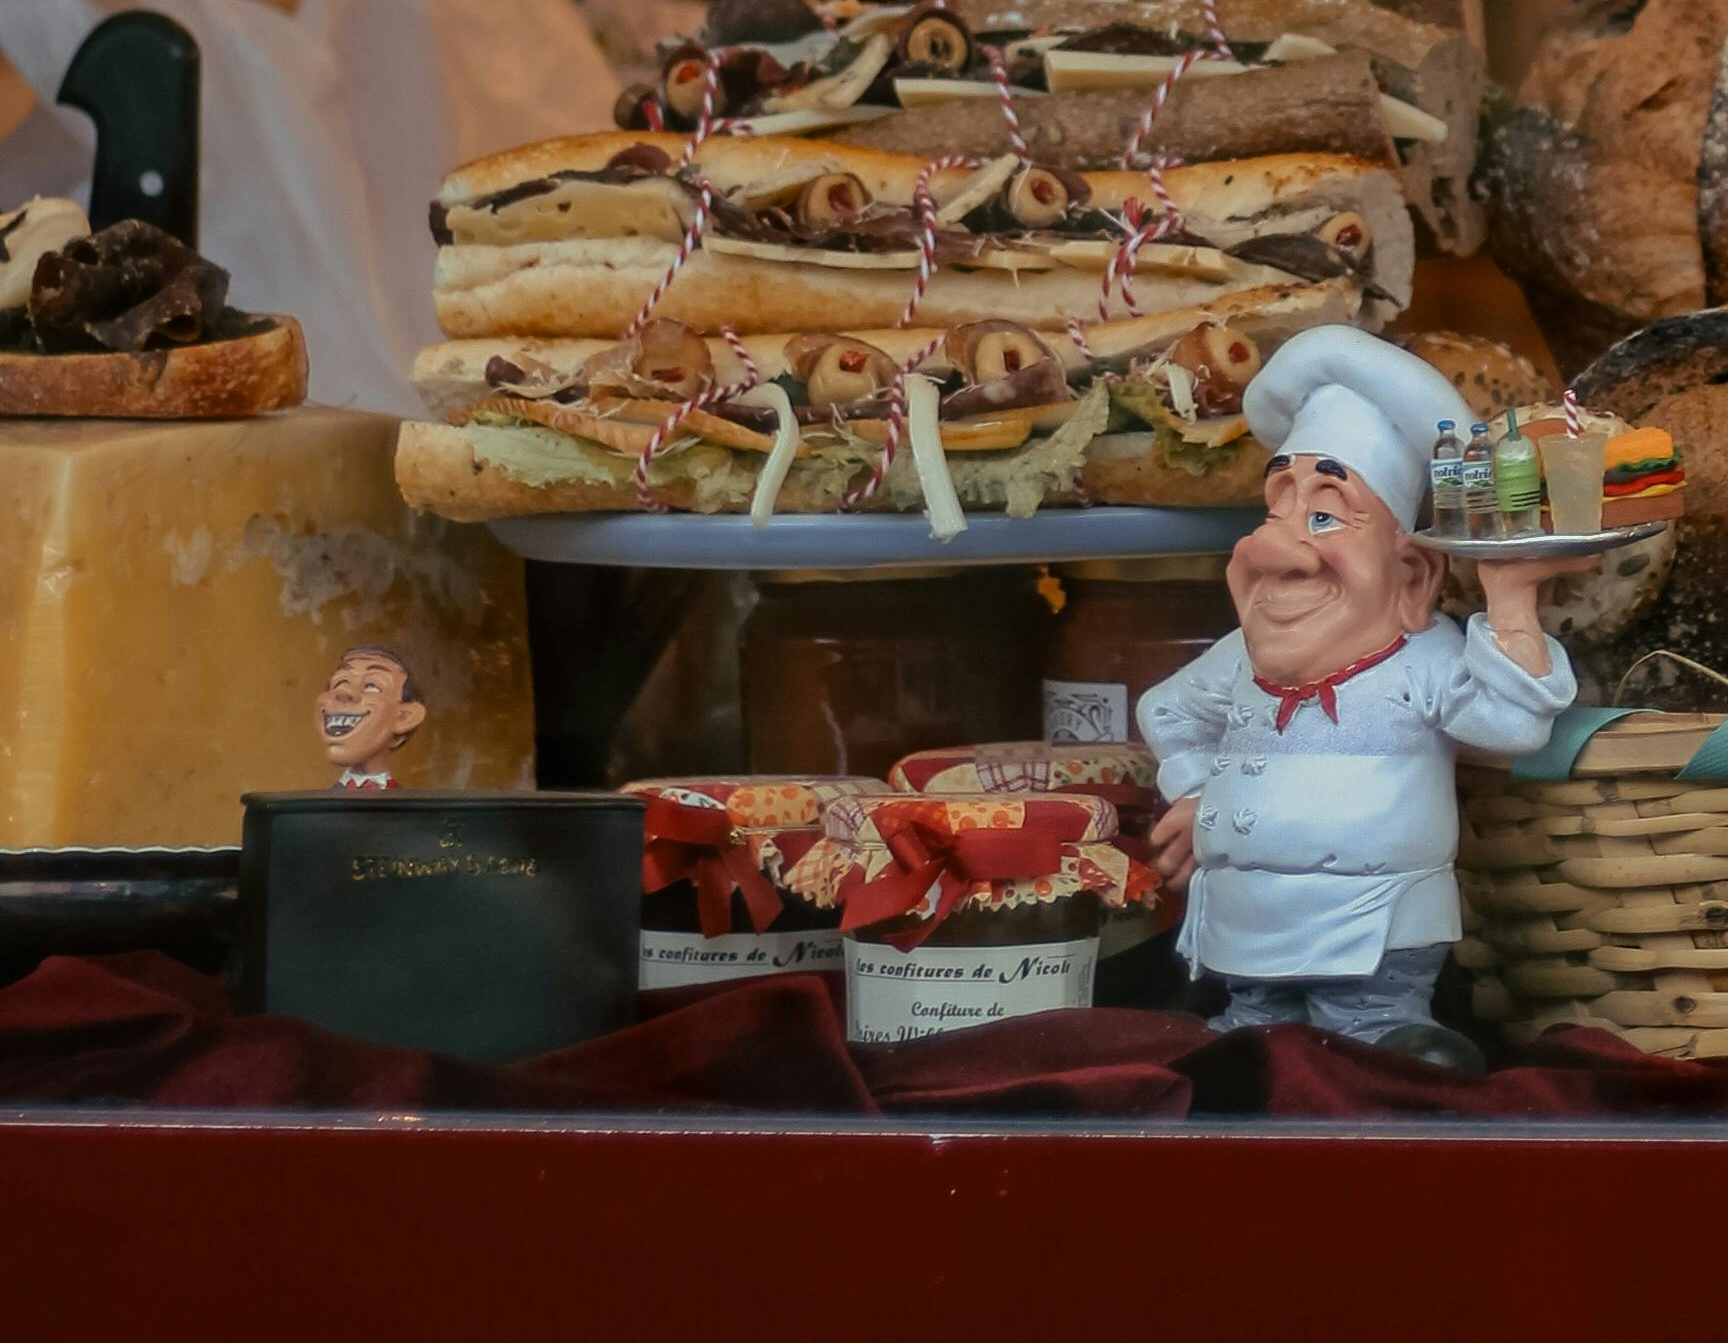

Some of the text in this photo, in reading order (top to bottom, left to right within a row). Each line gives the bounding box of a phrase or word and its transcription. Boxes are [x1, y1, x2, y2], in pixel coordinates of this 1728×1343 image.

[659, 946, 738, 963] confitures
[747, 948, 766, 962] de
[880, 962, 964, 979] confitures
[973, 963, 993, 979] de
[911, 1001, 1005, 1021] Confiture de
